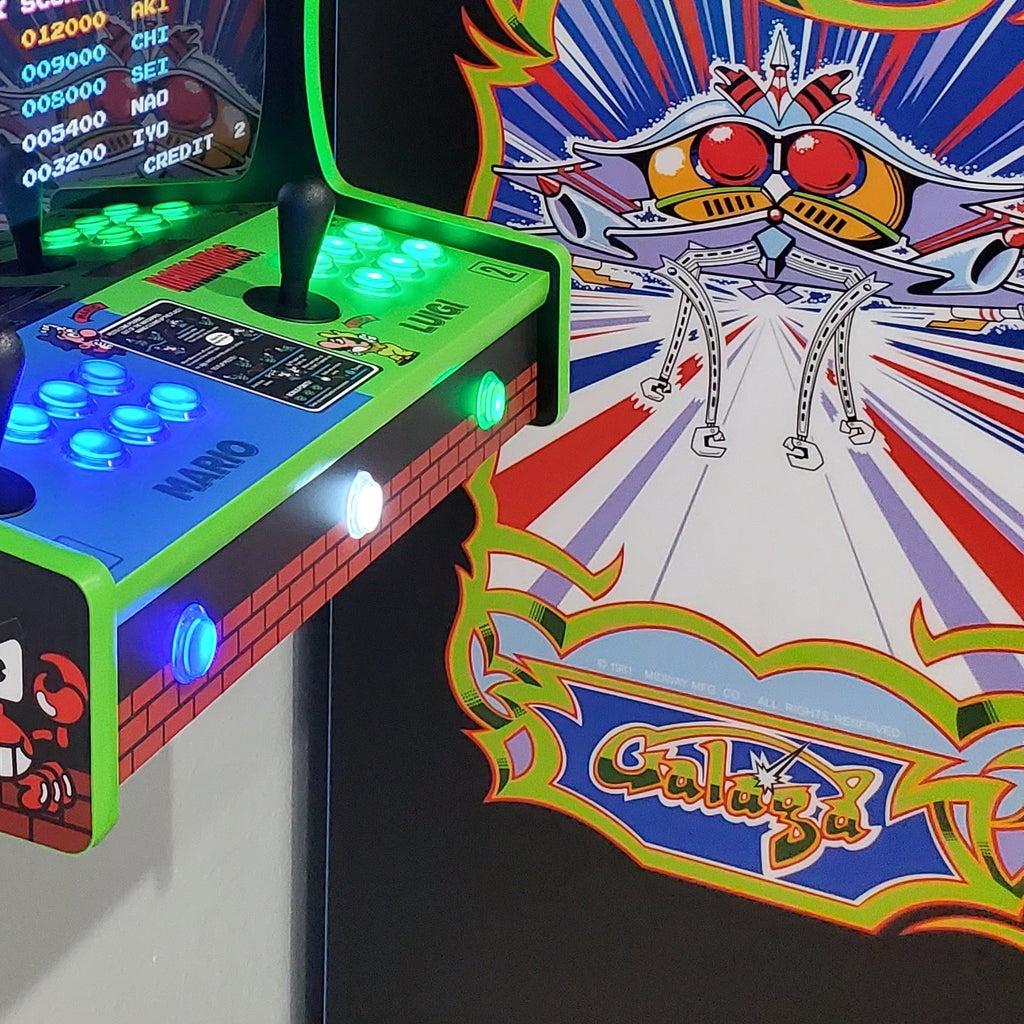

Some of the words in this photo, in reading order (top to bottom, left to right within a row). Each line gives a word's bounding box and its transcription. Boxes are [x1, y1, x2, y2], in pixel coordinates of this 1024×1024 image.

[20, 11, 108, 49] 012000
[21, 43, 107, 83] 009000
[131, 25, 170, 51] CHI
[21, 77, 107, 119] 008000
[131, 56, 169, 85] SEI
[22, 111, 107, 154] 005400
[131, 89, 169, 117] NAO
[143, 133, 214, 176] CREDIT
[233, 122, 246, 140] 2
[22, 144, 107, 188] 003200
[132, 121, 169, 148] IYO
[479, 266, 517, 279] 2
[398, 298, 470, 334] LUIGI
[151, 439, 260, 501] MARIO
[594, 725, 873, 868] Galaga
